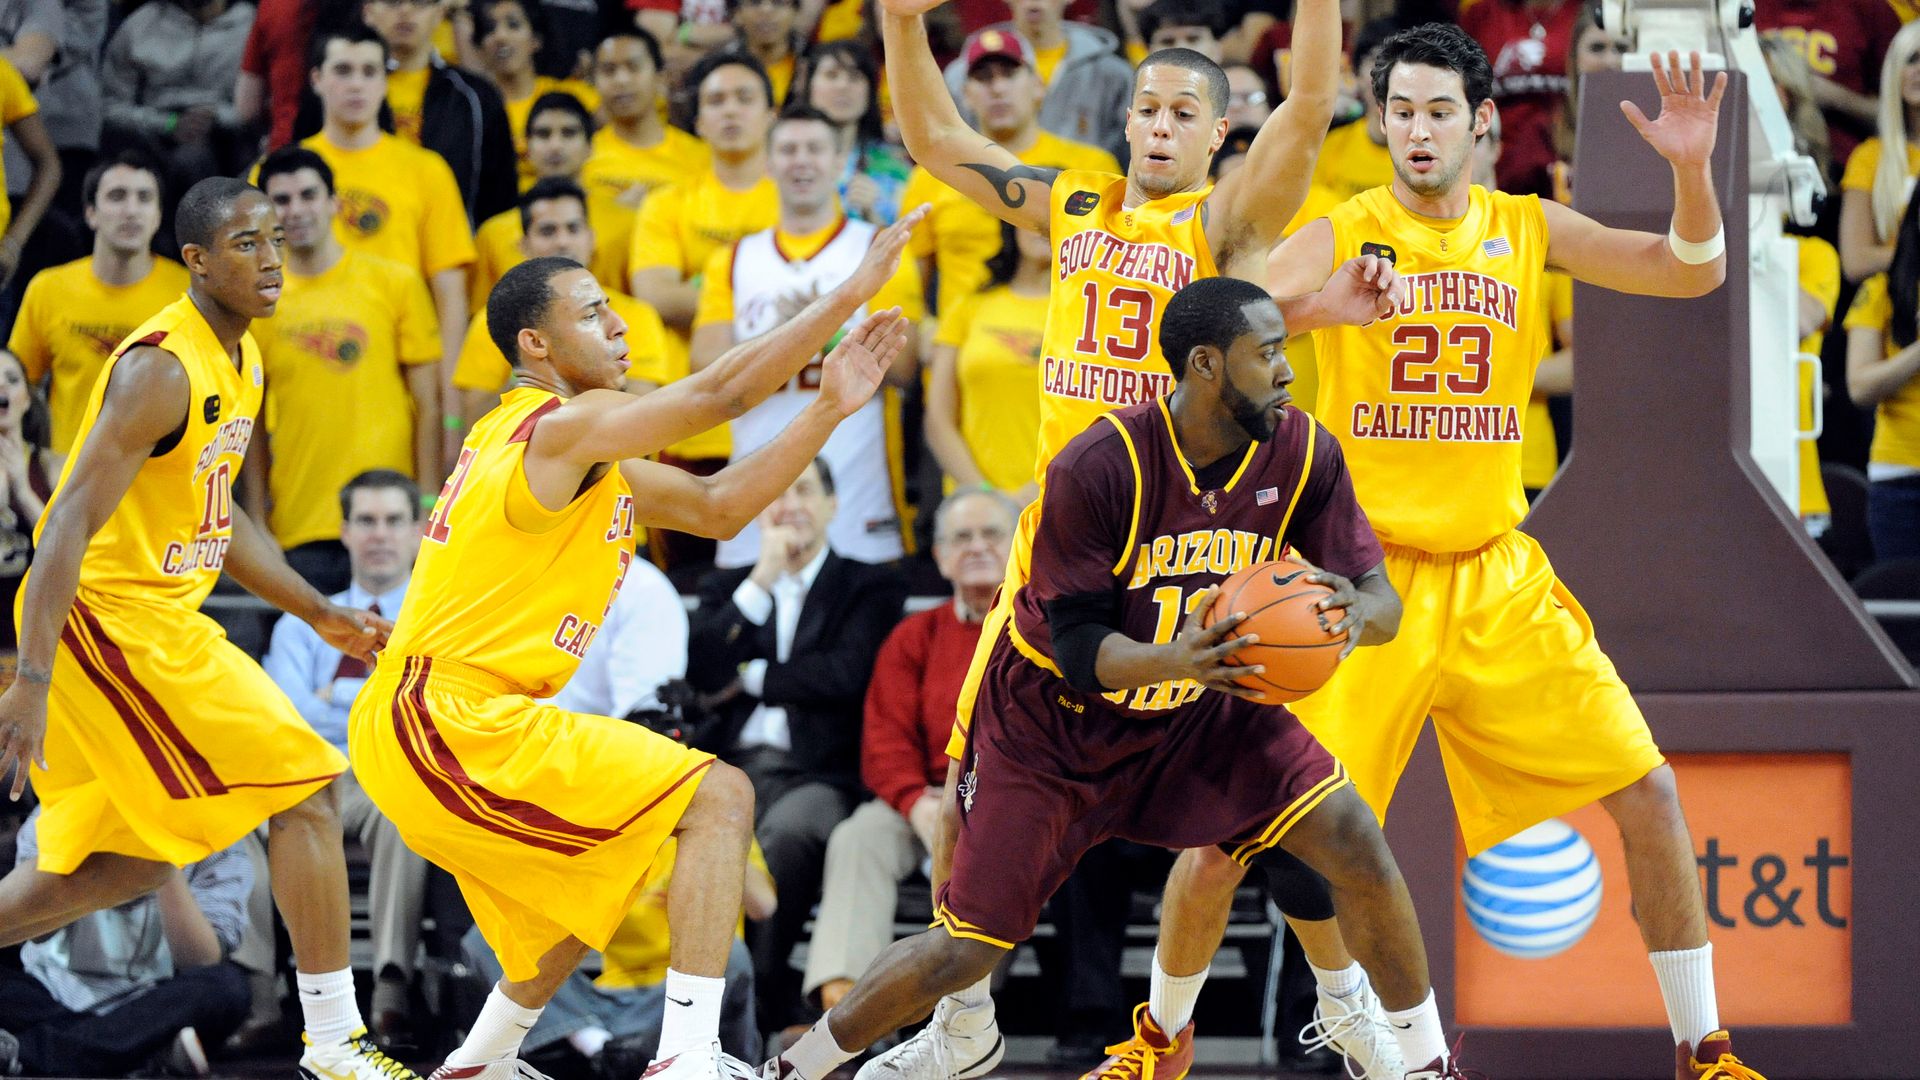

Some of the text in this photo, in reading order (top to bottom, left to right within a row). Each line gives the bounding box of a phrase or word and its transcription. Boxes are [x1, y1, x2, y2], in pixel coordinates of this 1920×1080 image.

[1059, 230, 1195, 292] SOUTHERN
[1076, 281, 1154, 362] 13
[1361, 271, 1518, 332] UTHERN
[1044, 356, 1171, 406] CALIFORNI
[1389, 324, 1492, 396] 23
[1351, 402, 1523, 443] CALIFORNIA
[199, 462, 231, 535] 10
[1152, 586, 1211, 644] 1
[1057, 694, 1085, 714] PAC-10
[1630, 838, 1849, 928] t&t
